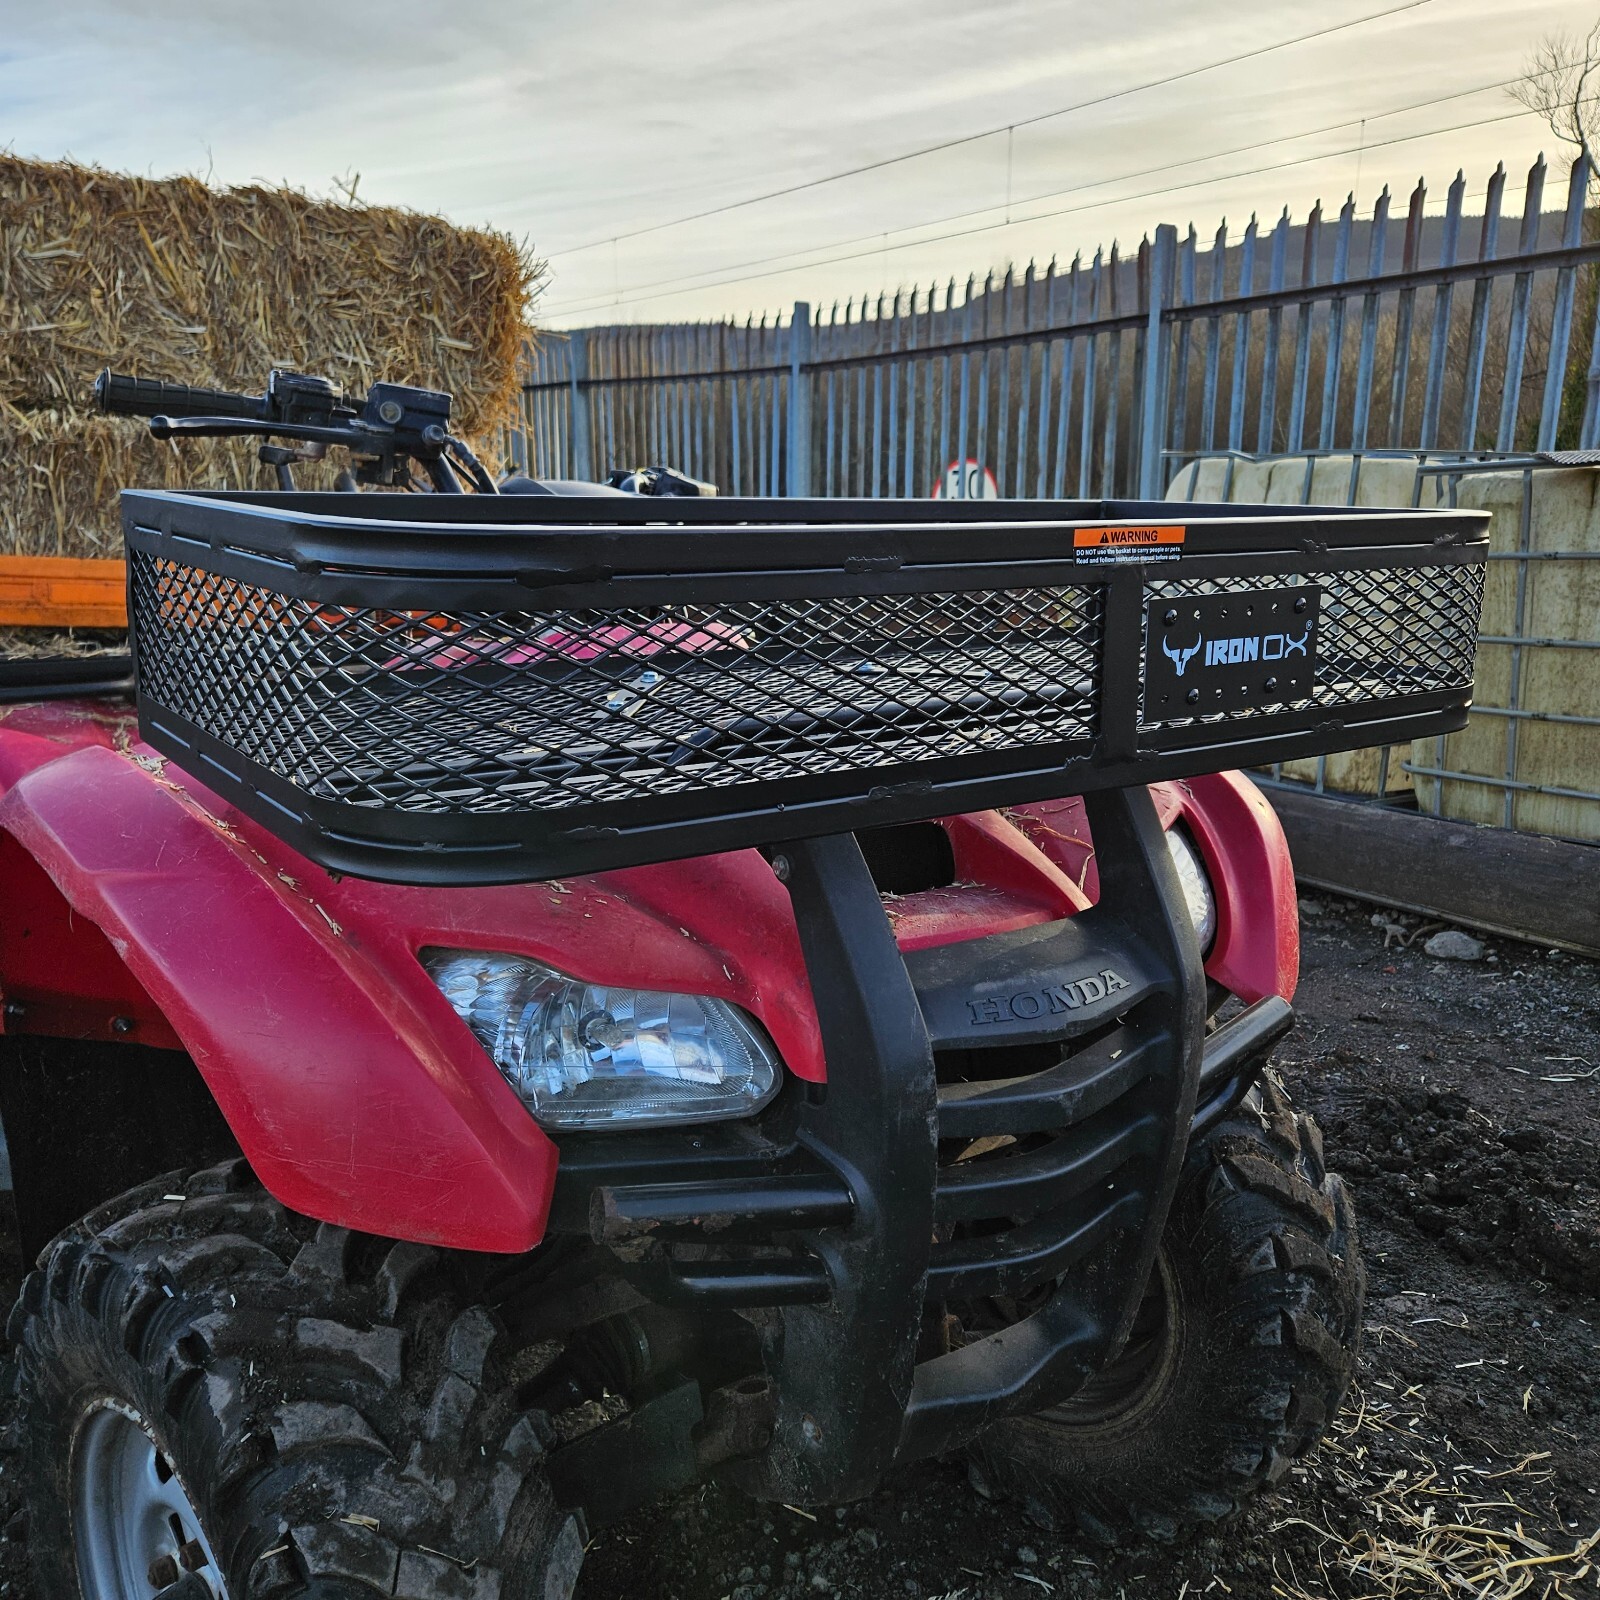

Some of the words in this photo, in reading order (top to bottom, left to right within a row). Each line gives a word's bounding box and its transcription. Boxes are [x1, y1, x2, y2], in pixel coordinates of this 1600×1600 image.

[1110, 530, 1158, 543] WARNING
[1085, 548, 1097, 556] NOT
[1205, 636, 1260, 667] IRON
[966, 968, 1131, 1026] HONDA
